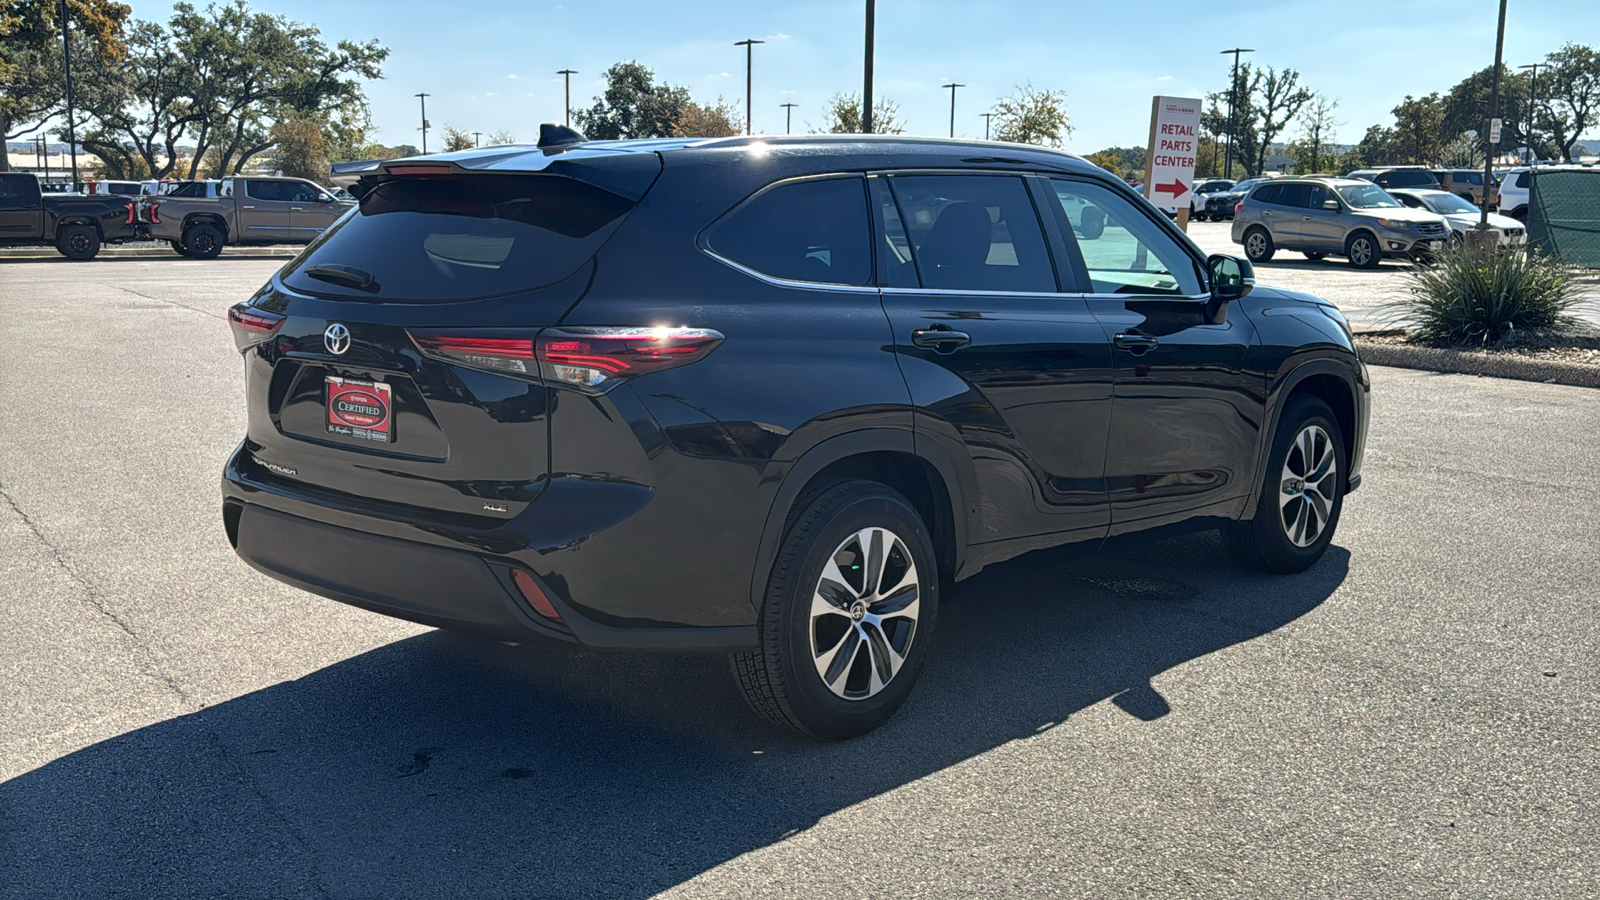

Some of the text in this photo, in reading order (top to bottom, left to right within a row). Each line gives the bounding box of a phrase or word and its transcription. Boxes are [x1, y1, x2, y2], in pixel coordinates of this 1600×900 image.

[1161, 124, 1194, 136] RETAIL
[1160, 140, 1192, 152] PARTS
[1154, 155, 1194, 167] CENTER
[352, 429, 366, 437] TOYOTA
[483, 502, 507, 512] XLE
